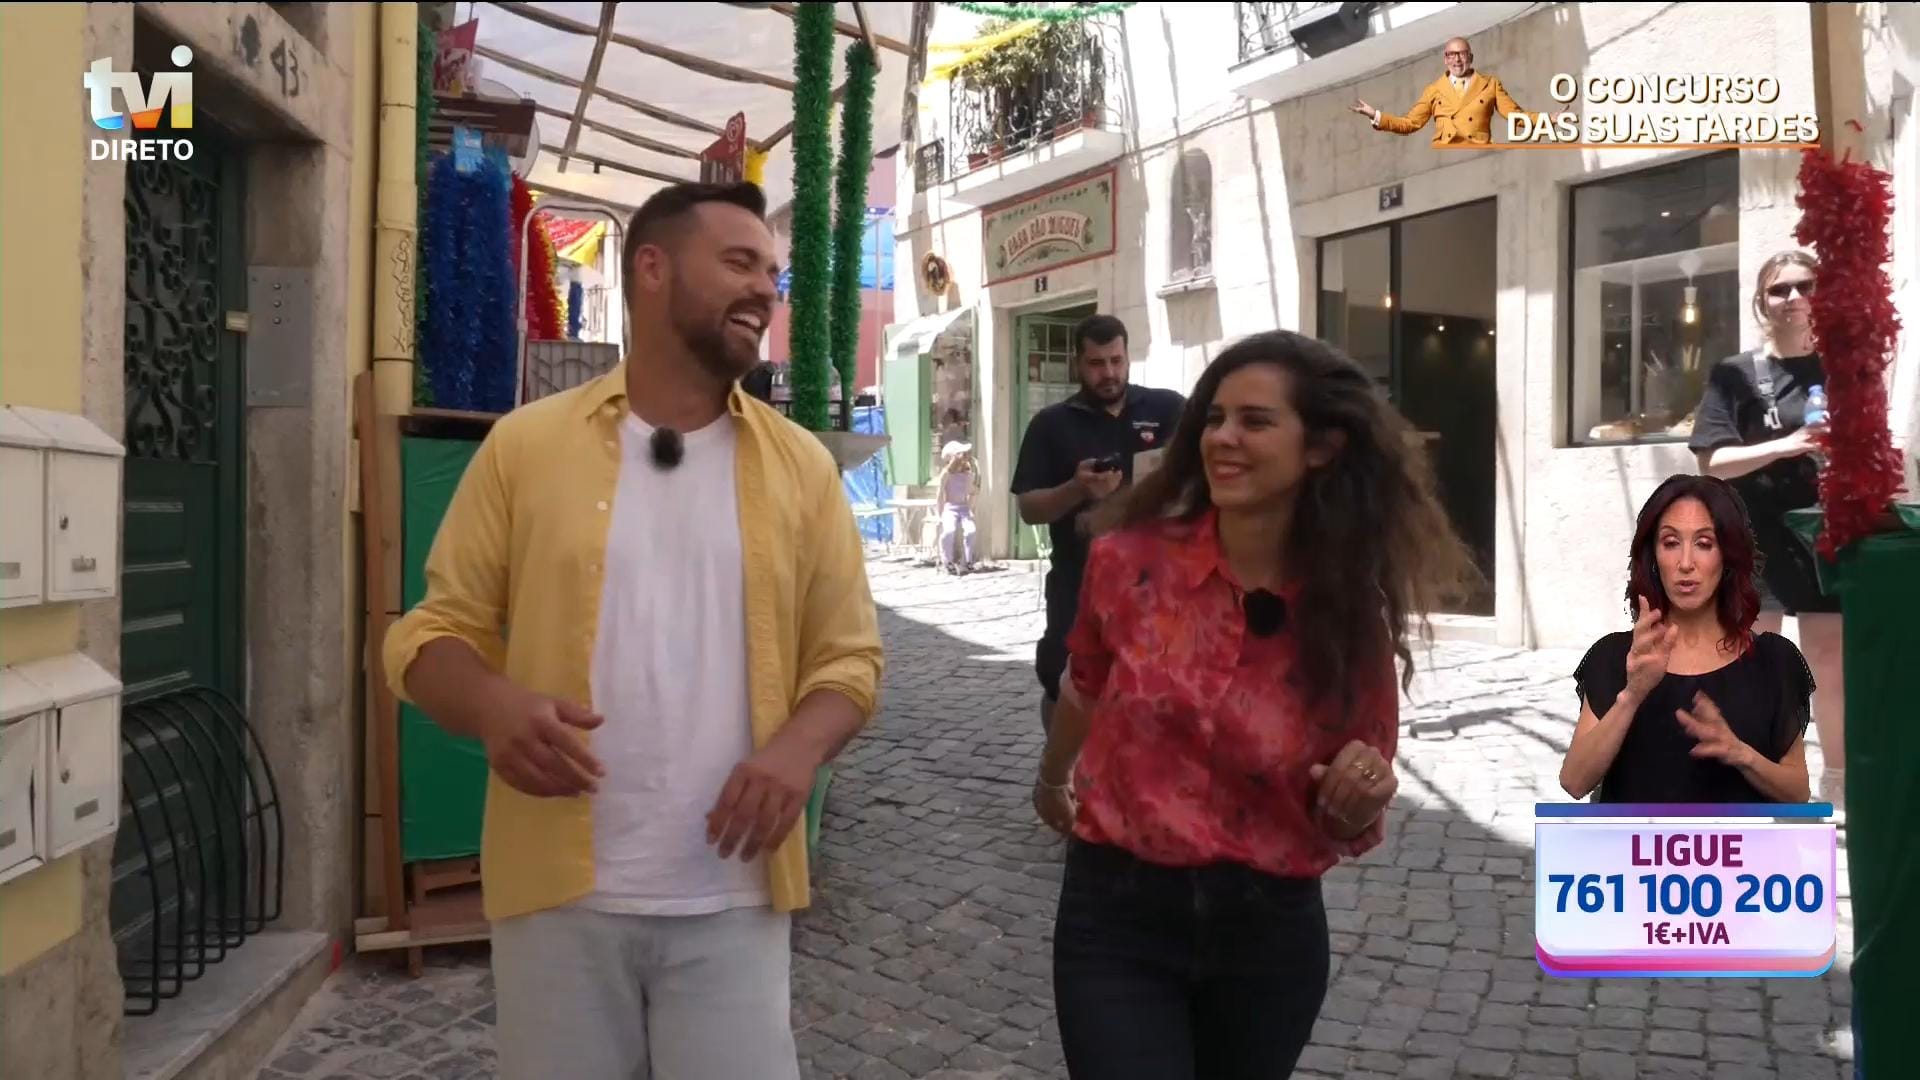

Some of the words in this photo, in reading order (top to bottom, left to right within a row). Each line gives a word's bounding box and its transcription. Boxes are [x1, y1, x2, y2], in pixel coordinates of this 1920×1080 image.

[1007, 228, 1030, 256] CASA
[1030, 217, 1046, 241] SÃO
[1047, 214, 1080, 239] MIGUEL
